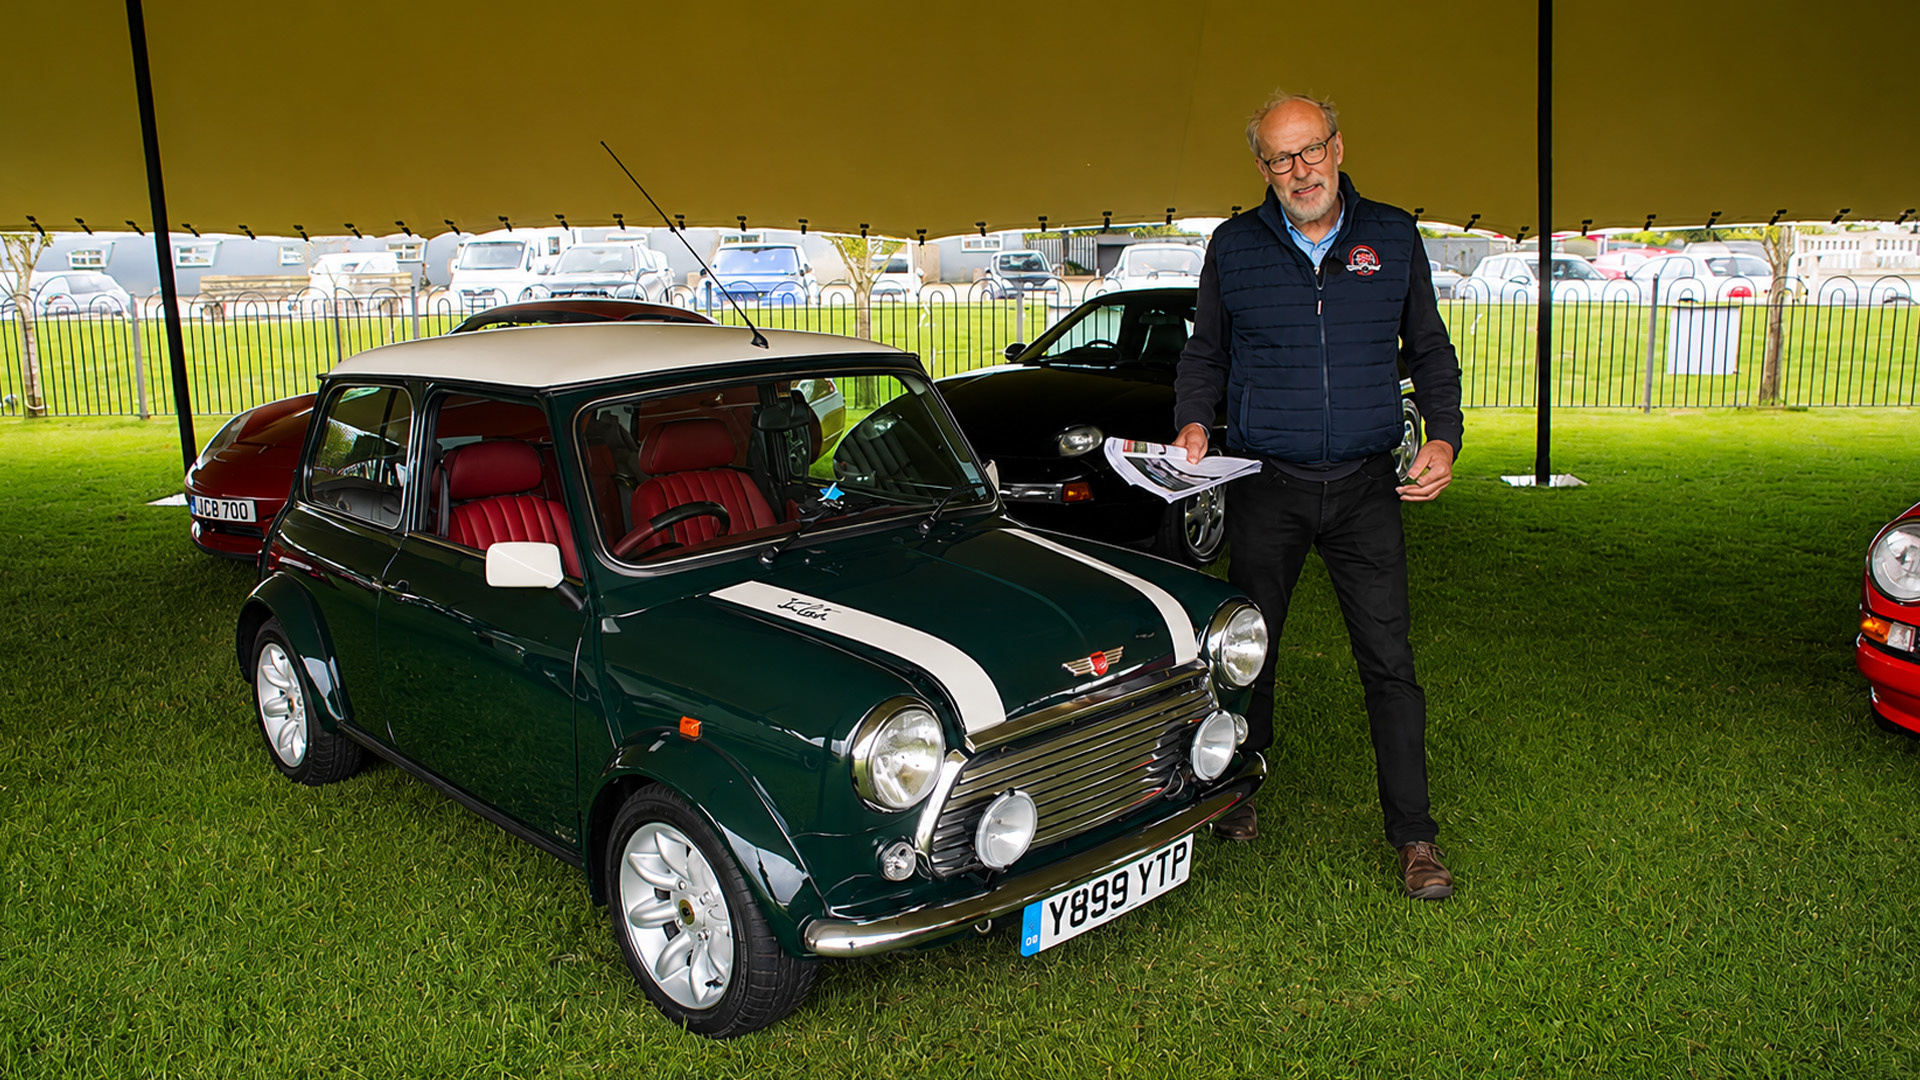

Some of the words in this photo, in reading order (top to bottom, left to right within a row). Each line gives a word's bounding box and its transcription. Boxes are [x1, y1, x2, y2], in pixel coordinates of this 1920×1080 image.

[198, 498, 219, 517] JCB
[222, 502, 248, 520] 700
[1049, 870, 1129, 936] Y899
[1138, 841, 1187, 896] YTP
